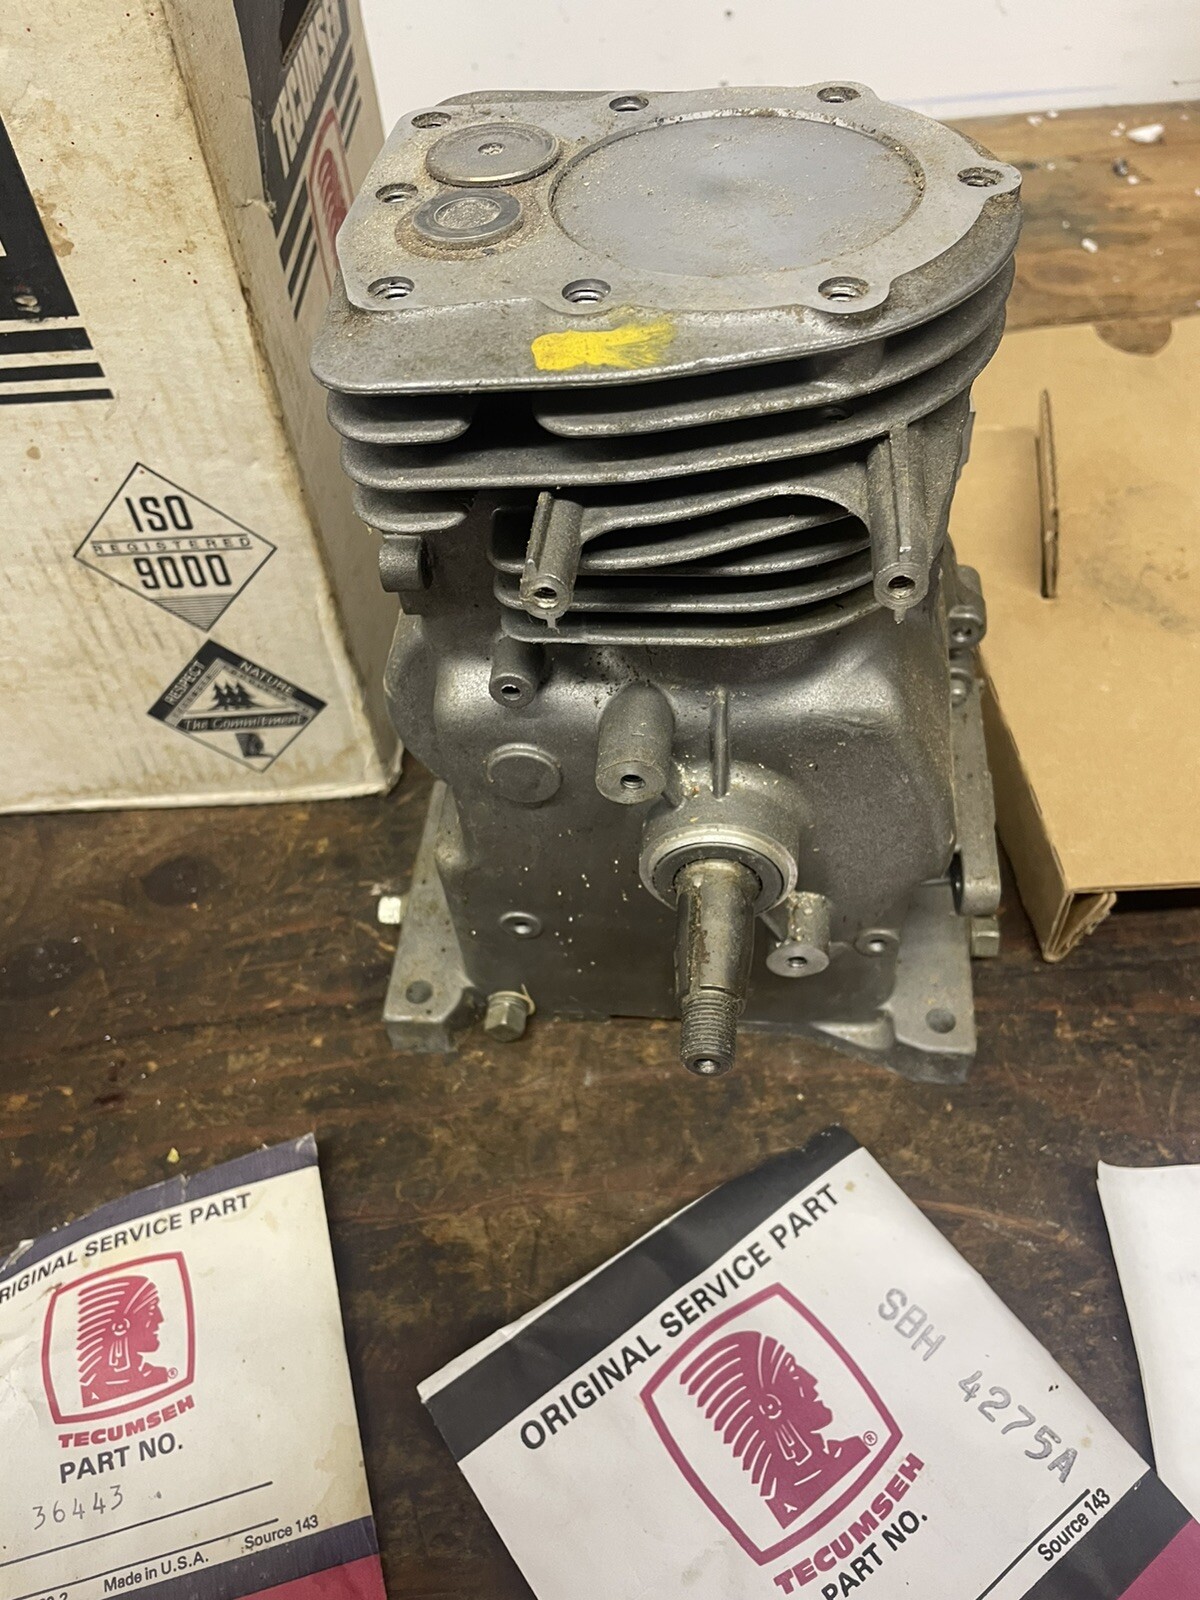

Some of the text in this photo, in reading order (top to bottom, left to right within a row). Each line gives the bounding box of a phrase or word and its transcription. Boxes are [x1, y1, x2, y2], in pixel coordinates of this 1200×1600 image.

[125, 495, 193, 532] ISO
[92, 536, 251, 554] REGISTERED
[133, 554, 232, 589] 9000
[164, 660, 205, 706] RESPECT
[239, 661, 296, 694] NATURE
[184, 715, 302, 731] The Commitment
[84, 1213, 183, 1257] SERVICE
[190, 1193, 251, 1225] PART
[519, 1183, 840, 1451] ORIGINAL SERVICE PART
[878, 1288, 1078, 1483] SBH 4275A
[58, 1395, 195, 1449] TECUMSEH
[59, 1432, 184, 1484] PART NO.
[33, 1484, 124, 1530] 36443
[773, 1452, 925, 1595] TECUMSEH
[1036, 1487, 1112, 1562] Source 143
[244, 1514, 319, 1549] Source 143
[103, 1551, 209, 1593] Made in U.S.A.
[821, 1510, 928, 1600] PART NO.
